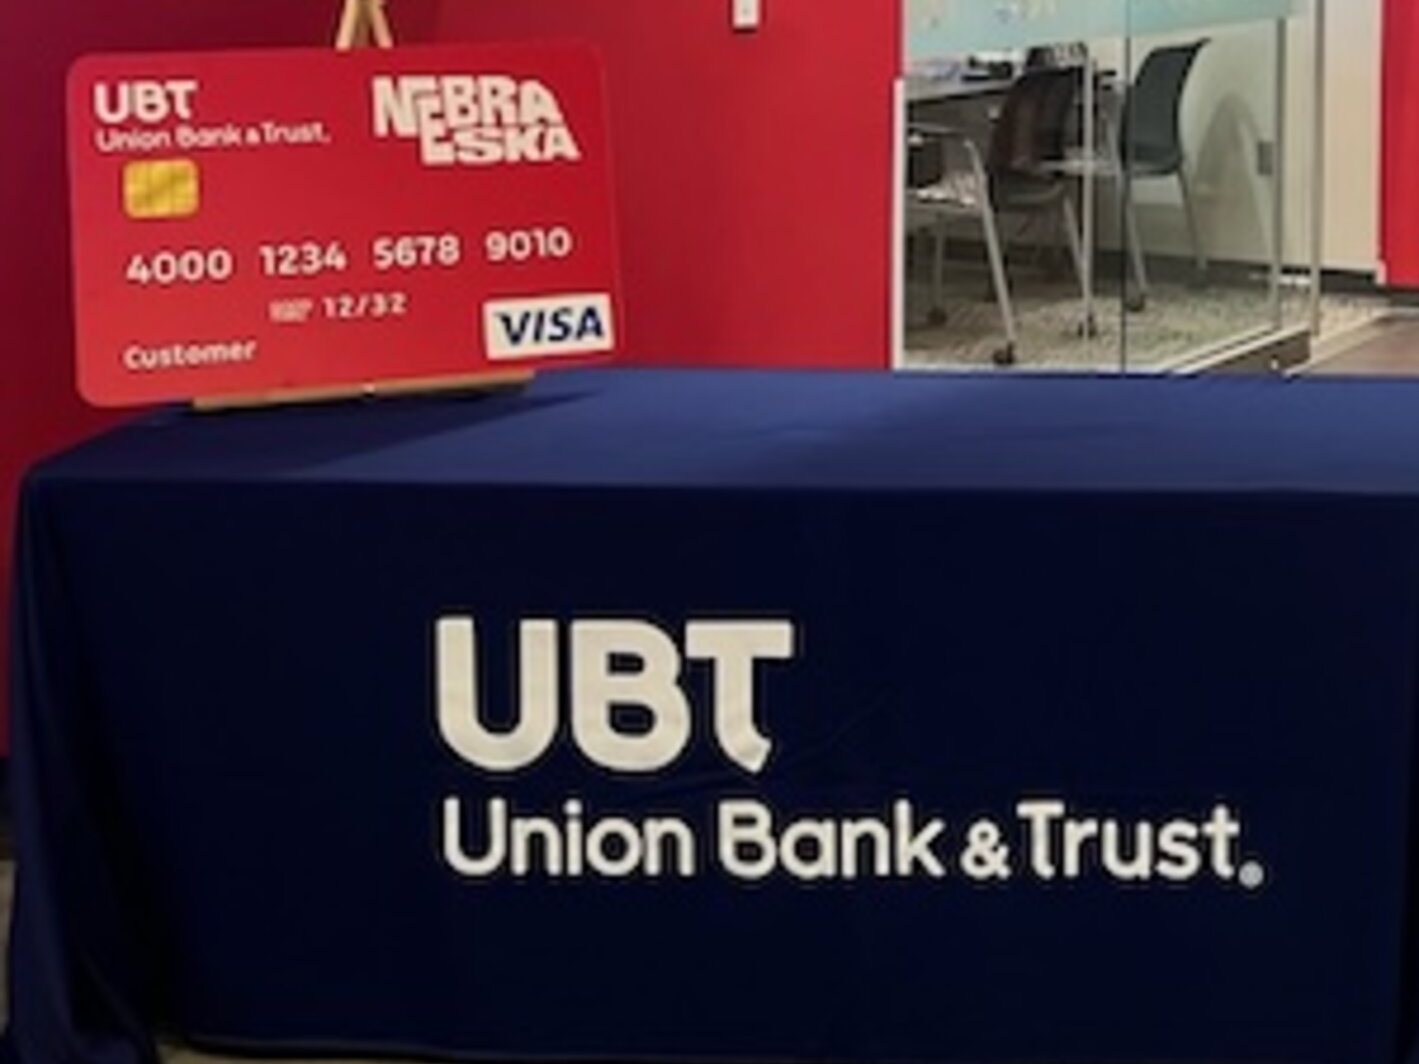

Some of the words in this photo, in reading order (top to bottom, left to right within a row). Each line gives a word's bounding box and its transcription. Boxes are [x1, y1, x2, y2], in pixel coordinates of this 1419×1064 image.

[94, 79, 199, 124] UBT
[96, 127, 171, 153] Union
[175, 123, 242, 149] Bank
[125, 248, 233, 285] 4000
[259, 241, 348, 276] 1234
[373, 234, 461, 270] 5678
[485, 226, 573, 262] 9010
[323, 292, 407, 319] 12/32
[500, 306, 605, 345] VISA
[123, 338, 257, 370] Customer
[435, 616, 795, 775] UBT
[443, 796, 696, 878] Union
[718, 798, 947, 880] Bank
